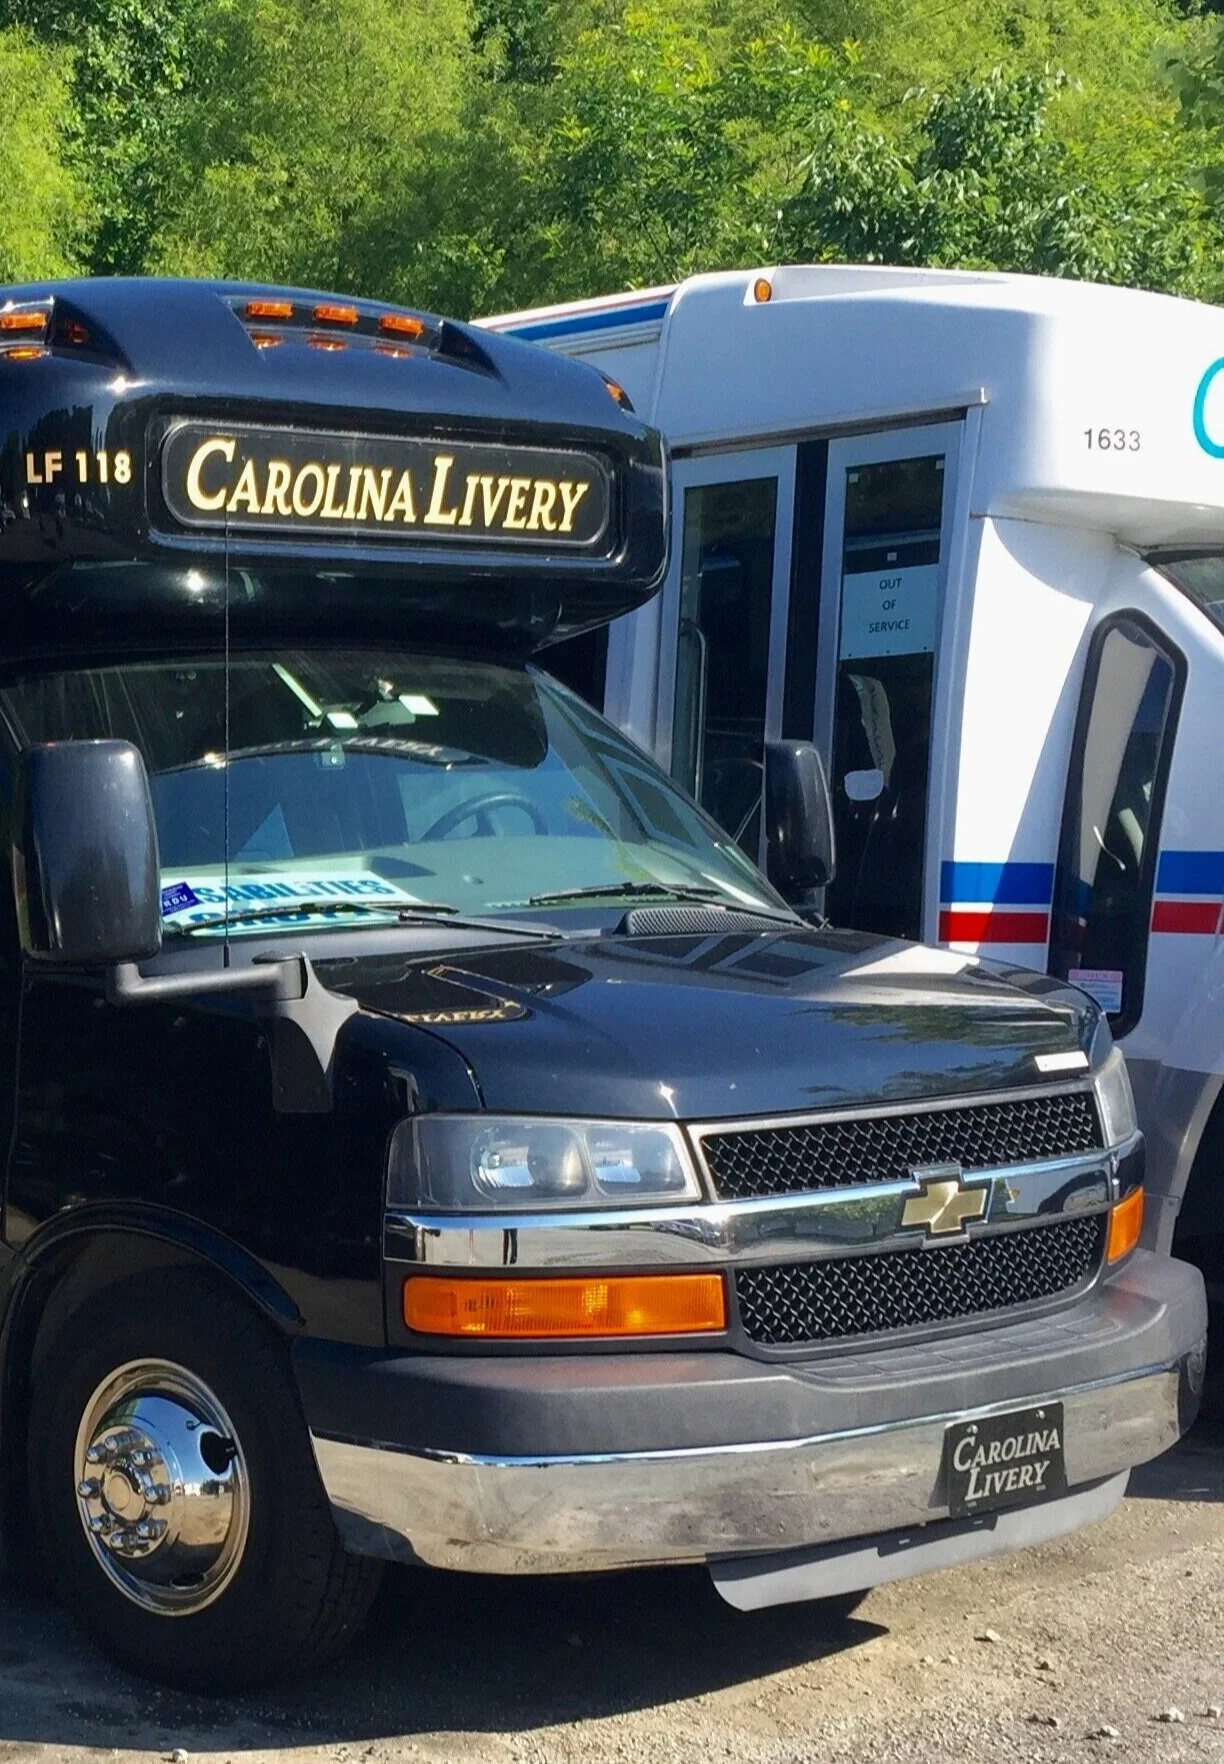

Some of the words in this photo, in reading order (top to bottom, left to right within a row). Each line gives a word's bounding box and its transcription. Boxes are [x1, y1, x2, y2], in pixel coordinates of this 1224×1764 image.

[1084, 428, 1141, 452] 1633
[25, 450, 63, 483] LF
[75, 451, 132, 484] 118
[186, 438, 416, 523] CAROLINA
[423, 456, 588, 532] LIVERY
[879, 578, 902, 590] OUT
[882, 599, 897, 611] OF
[868, 619, 911, 633] SERVICE
[953, 1428, 1061, 1472] CAROLINA
[965, 1460, 1051, 1501] LIVERY
